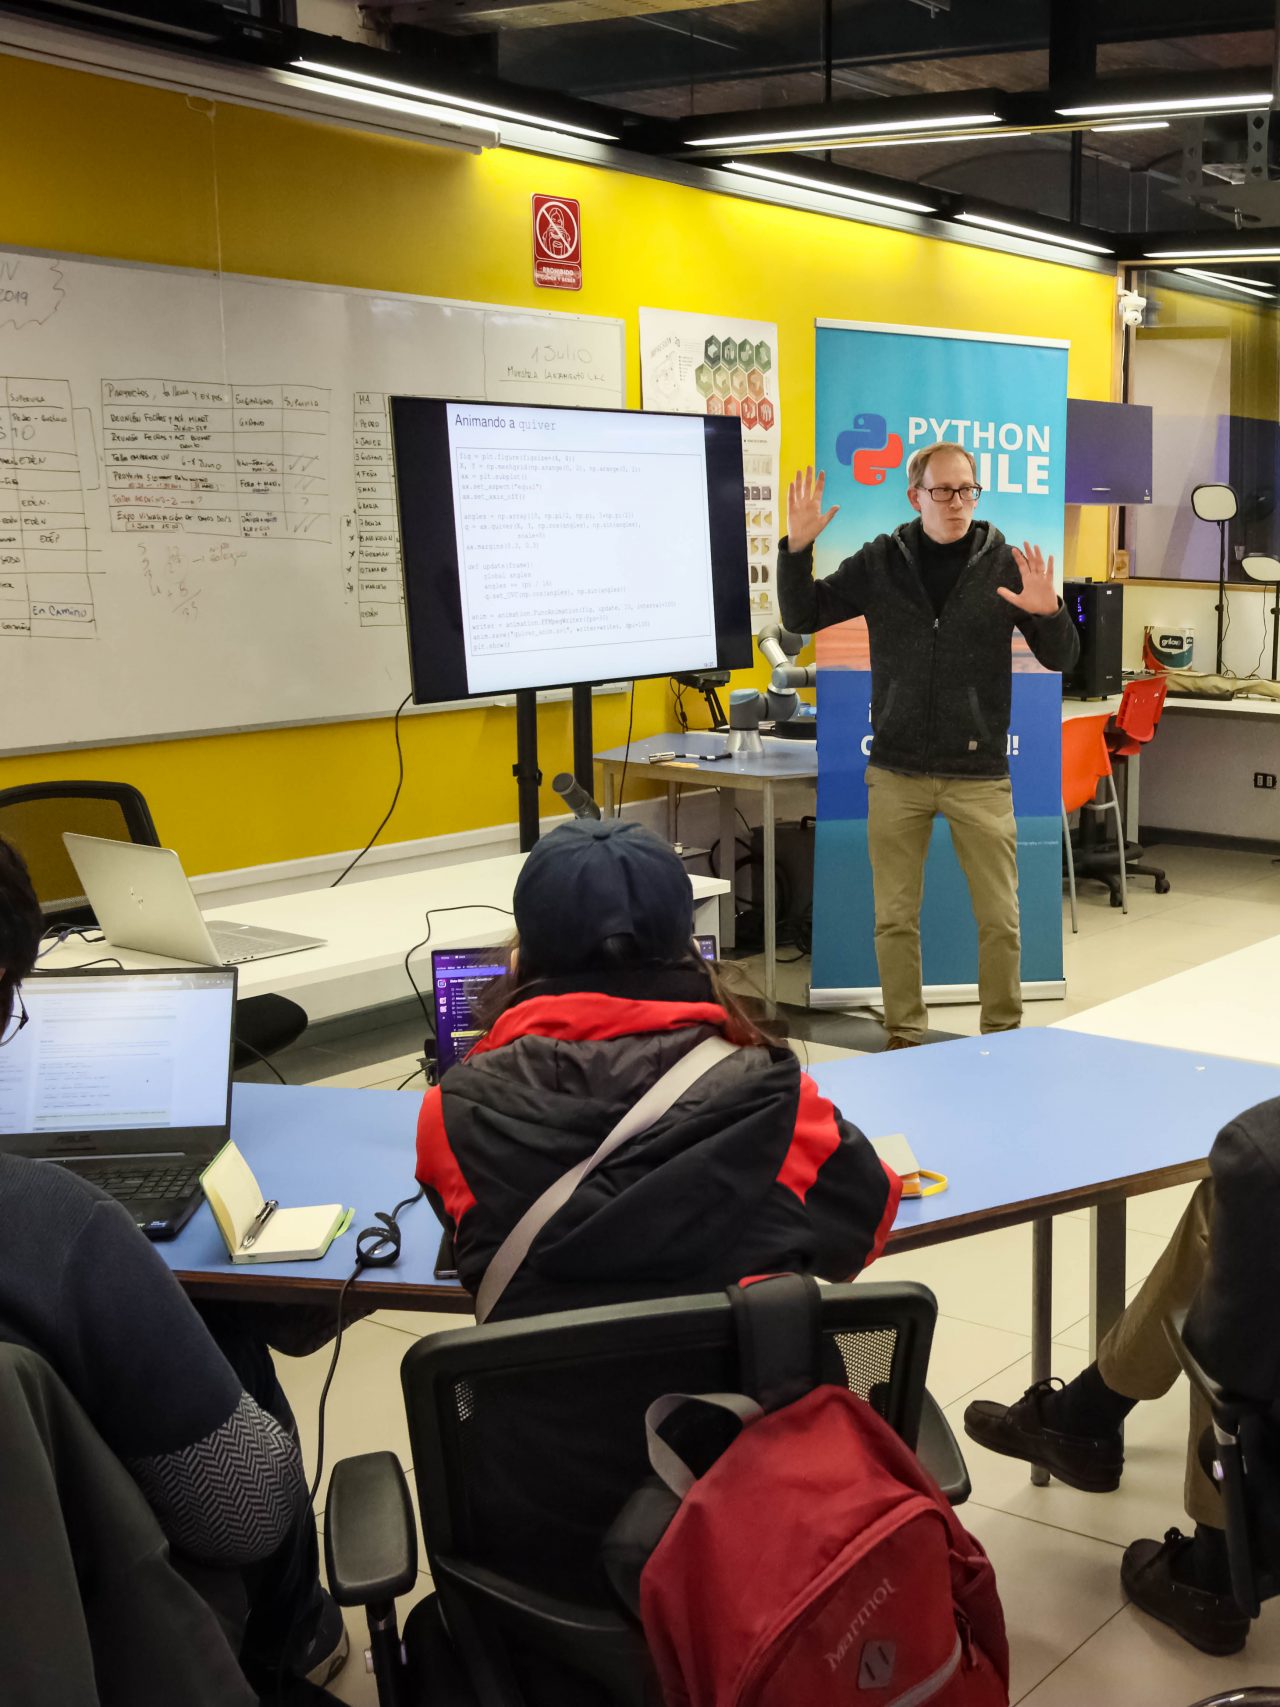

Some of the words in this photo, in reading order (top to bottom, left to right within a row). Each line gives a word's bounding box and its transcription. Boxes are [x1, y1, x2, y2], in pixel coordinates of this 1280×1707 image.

[455, 413, 507, 429] Animando
[509, 418, 516, 429] a
[518, 419, 558, 432] quiver
[908, 416, 1050, 453] PYTHON
[824, 1577, 897, 1673] Marmot
